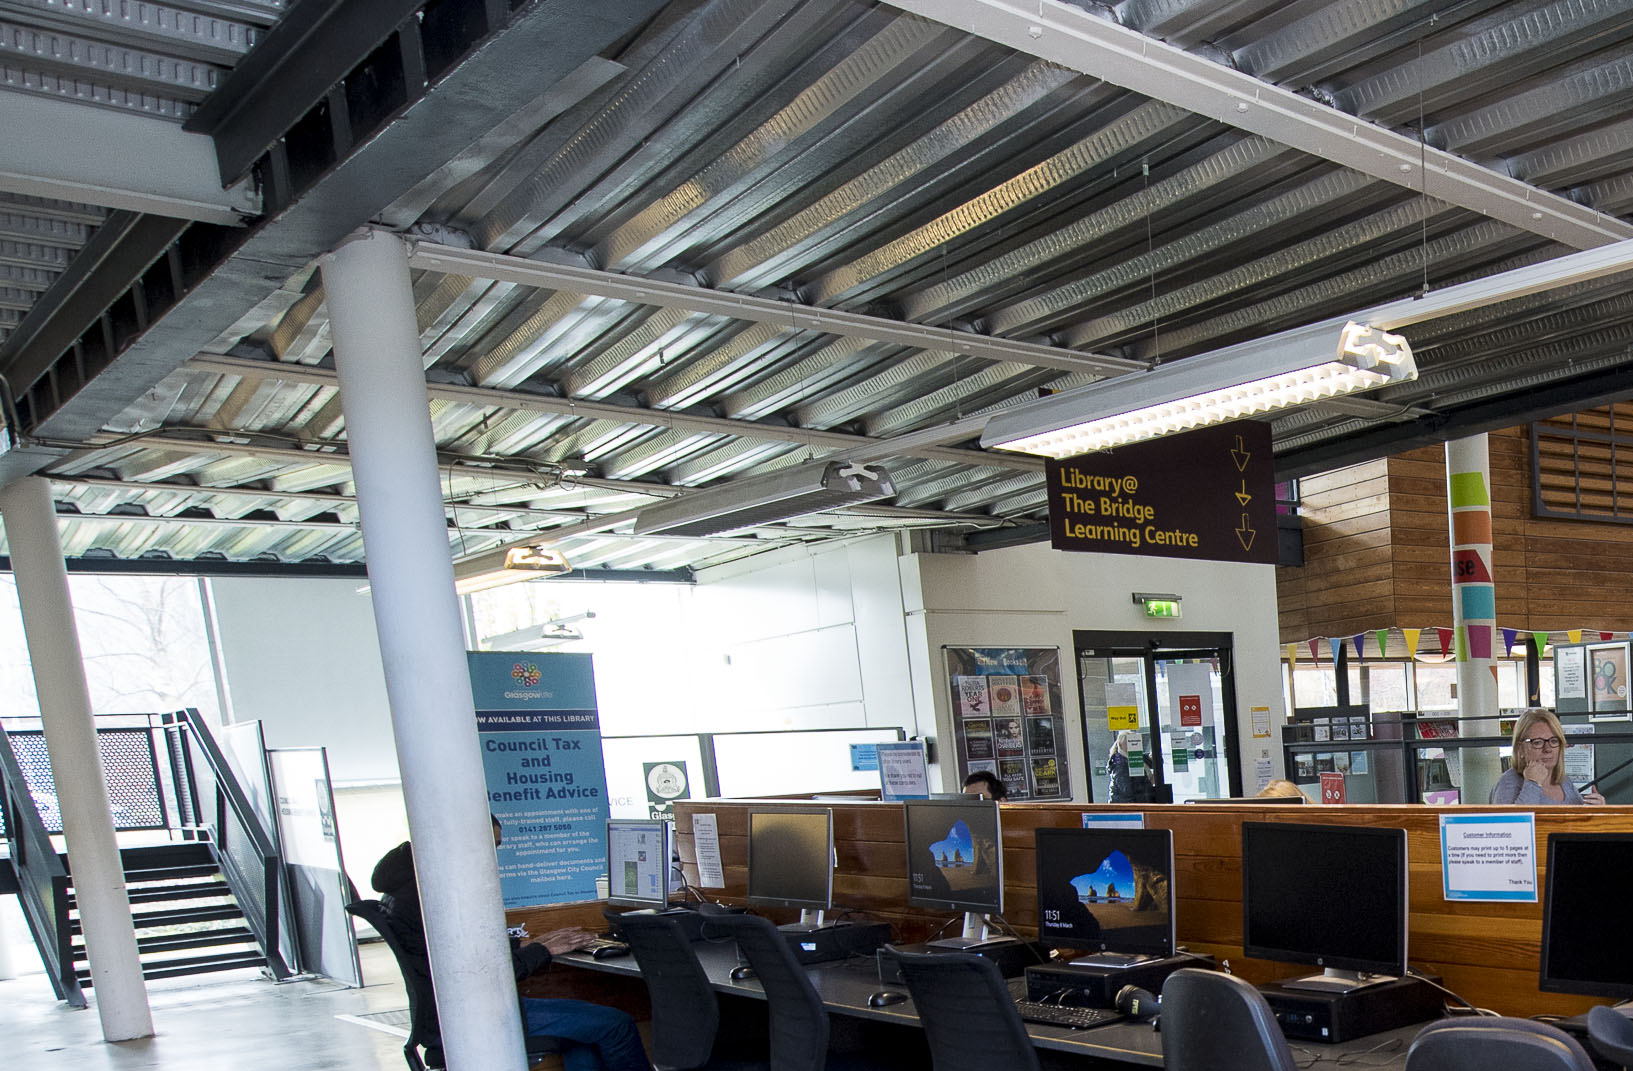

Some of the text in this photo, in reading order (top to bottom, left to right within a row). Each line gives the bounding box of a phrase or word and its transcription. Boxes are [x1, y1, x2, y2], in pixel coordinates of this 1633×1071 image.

[1061, 468, 1138, 496] Library@
[1062, 494, 1155, 524] The Bridge
[1065, 519, 1198, 548] Learning Centre
[488, 715, 531, 723] AVAILABLE
[486, 738, 581, 752] Council Tax
[521, 754, 552, 768] and
[506, 771, 574, 785] Housing
[546, 785, 598, 800] Advice
[539, 867, 566, 875] Glasgow
[1045, 910, 1060, 920] 11:51
